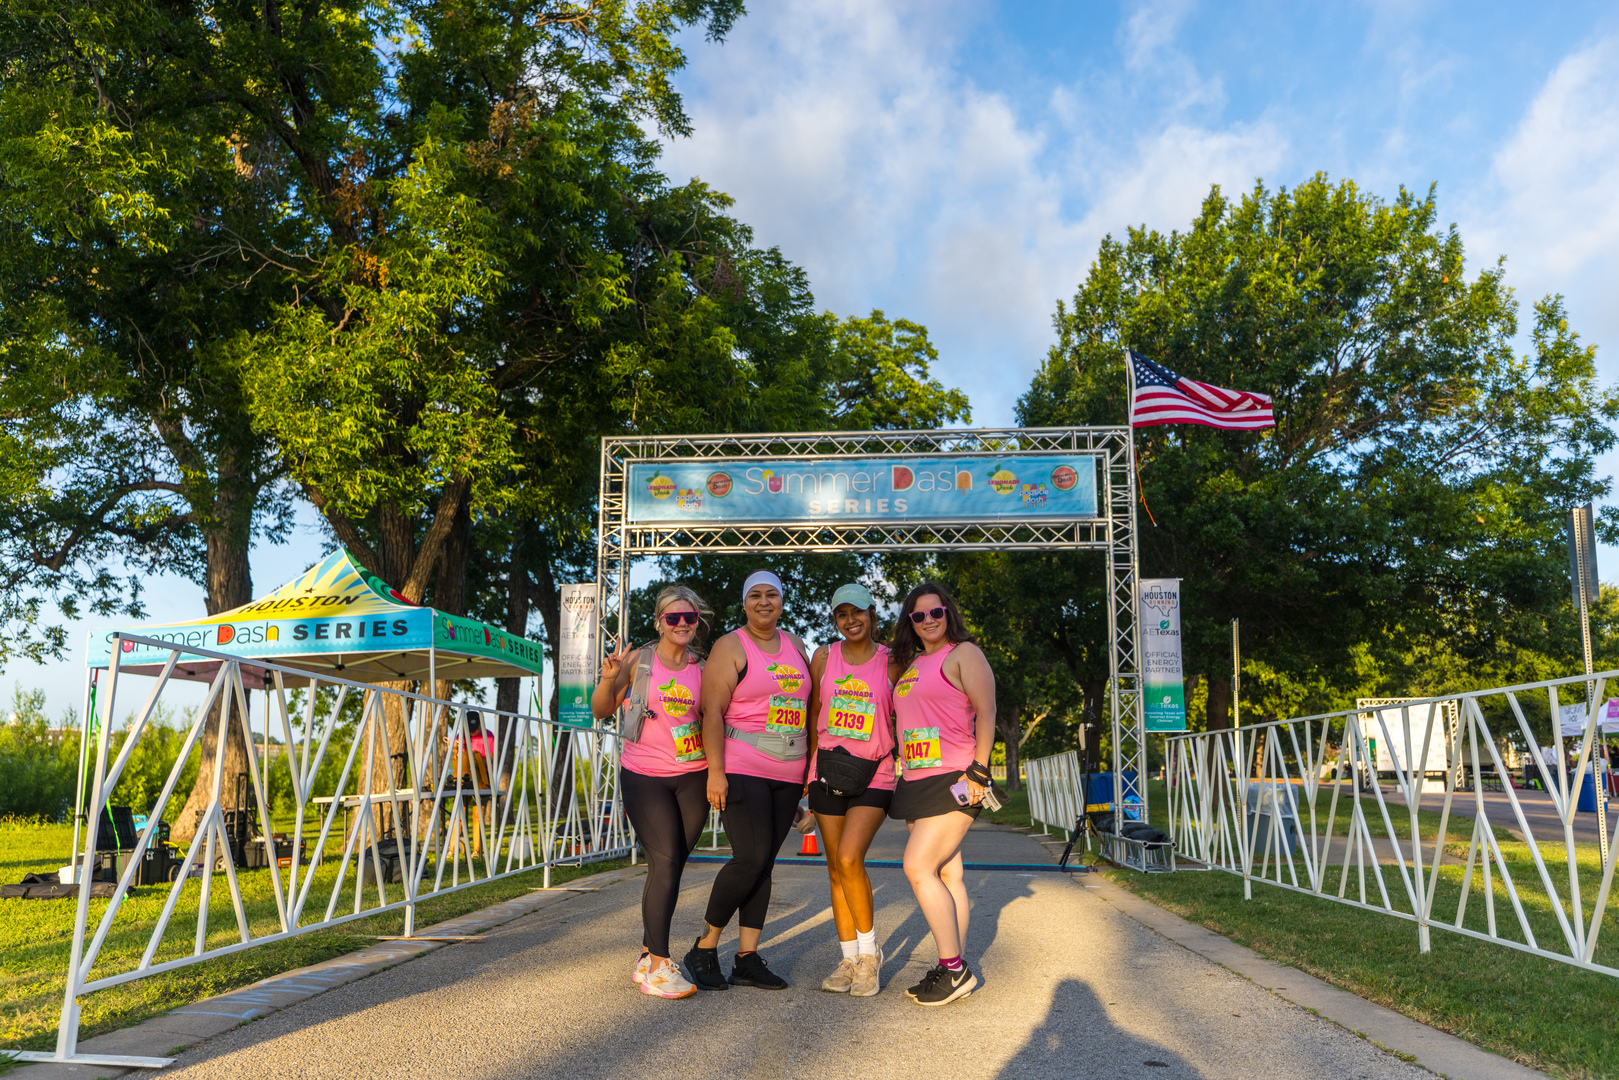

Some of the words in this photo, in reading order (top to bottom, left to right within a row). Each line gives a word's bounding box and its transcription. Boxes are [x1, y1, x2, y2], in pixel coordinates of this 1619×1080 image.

[744, 467, 885, 495] Summer
[891, 464, 973, 492] Dash
[995, 483, 1014, 491] Dash
[654, 488, 670, 496] Dash
[809, 498, 908, 515] SERIES
[238, 595, 360, 613] HOUSTON
[565, 596, 595, 604] HOUSTON
[1144, 591, 1177, 600] HOUSTON
[217, 622, 280, 646] Dash
[292, 619, 409, 641] SERIES
[441, 616, 483, 645] Summer
[508, 638, 539, 663] SERIES
[1144, 651, 1180, 659] OFFICIAL
[659, 695, 696, 706] LEMONADE
[834, 689, 874, 698] LEMONADE
[775, 708, 801, 726] 2138
[834, 711, 865, 730] 2139
[906, 741, 930, 760] 2147
